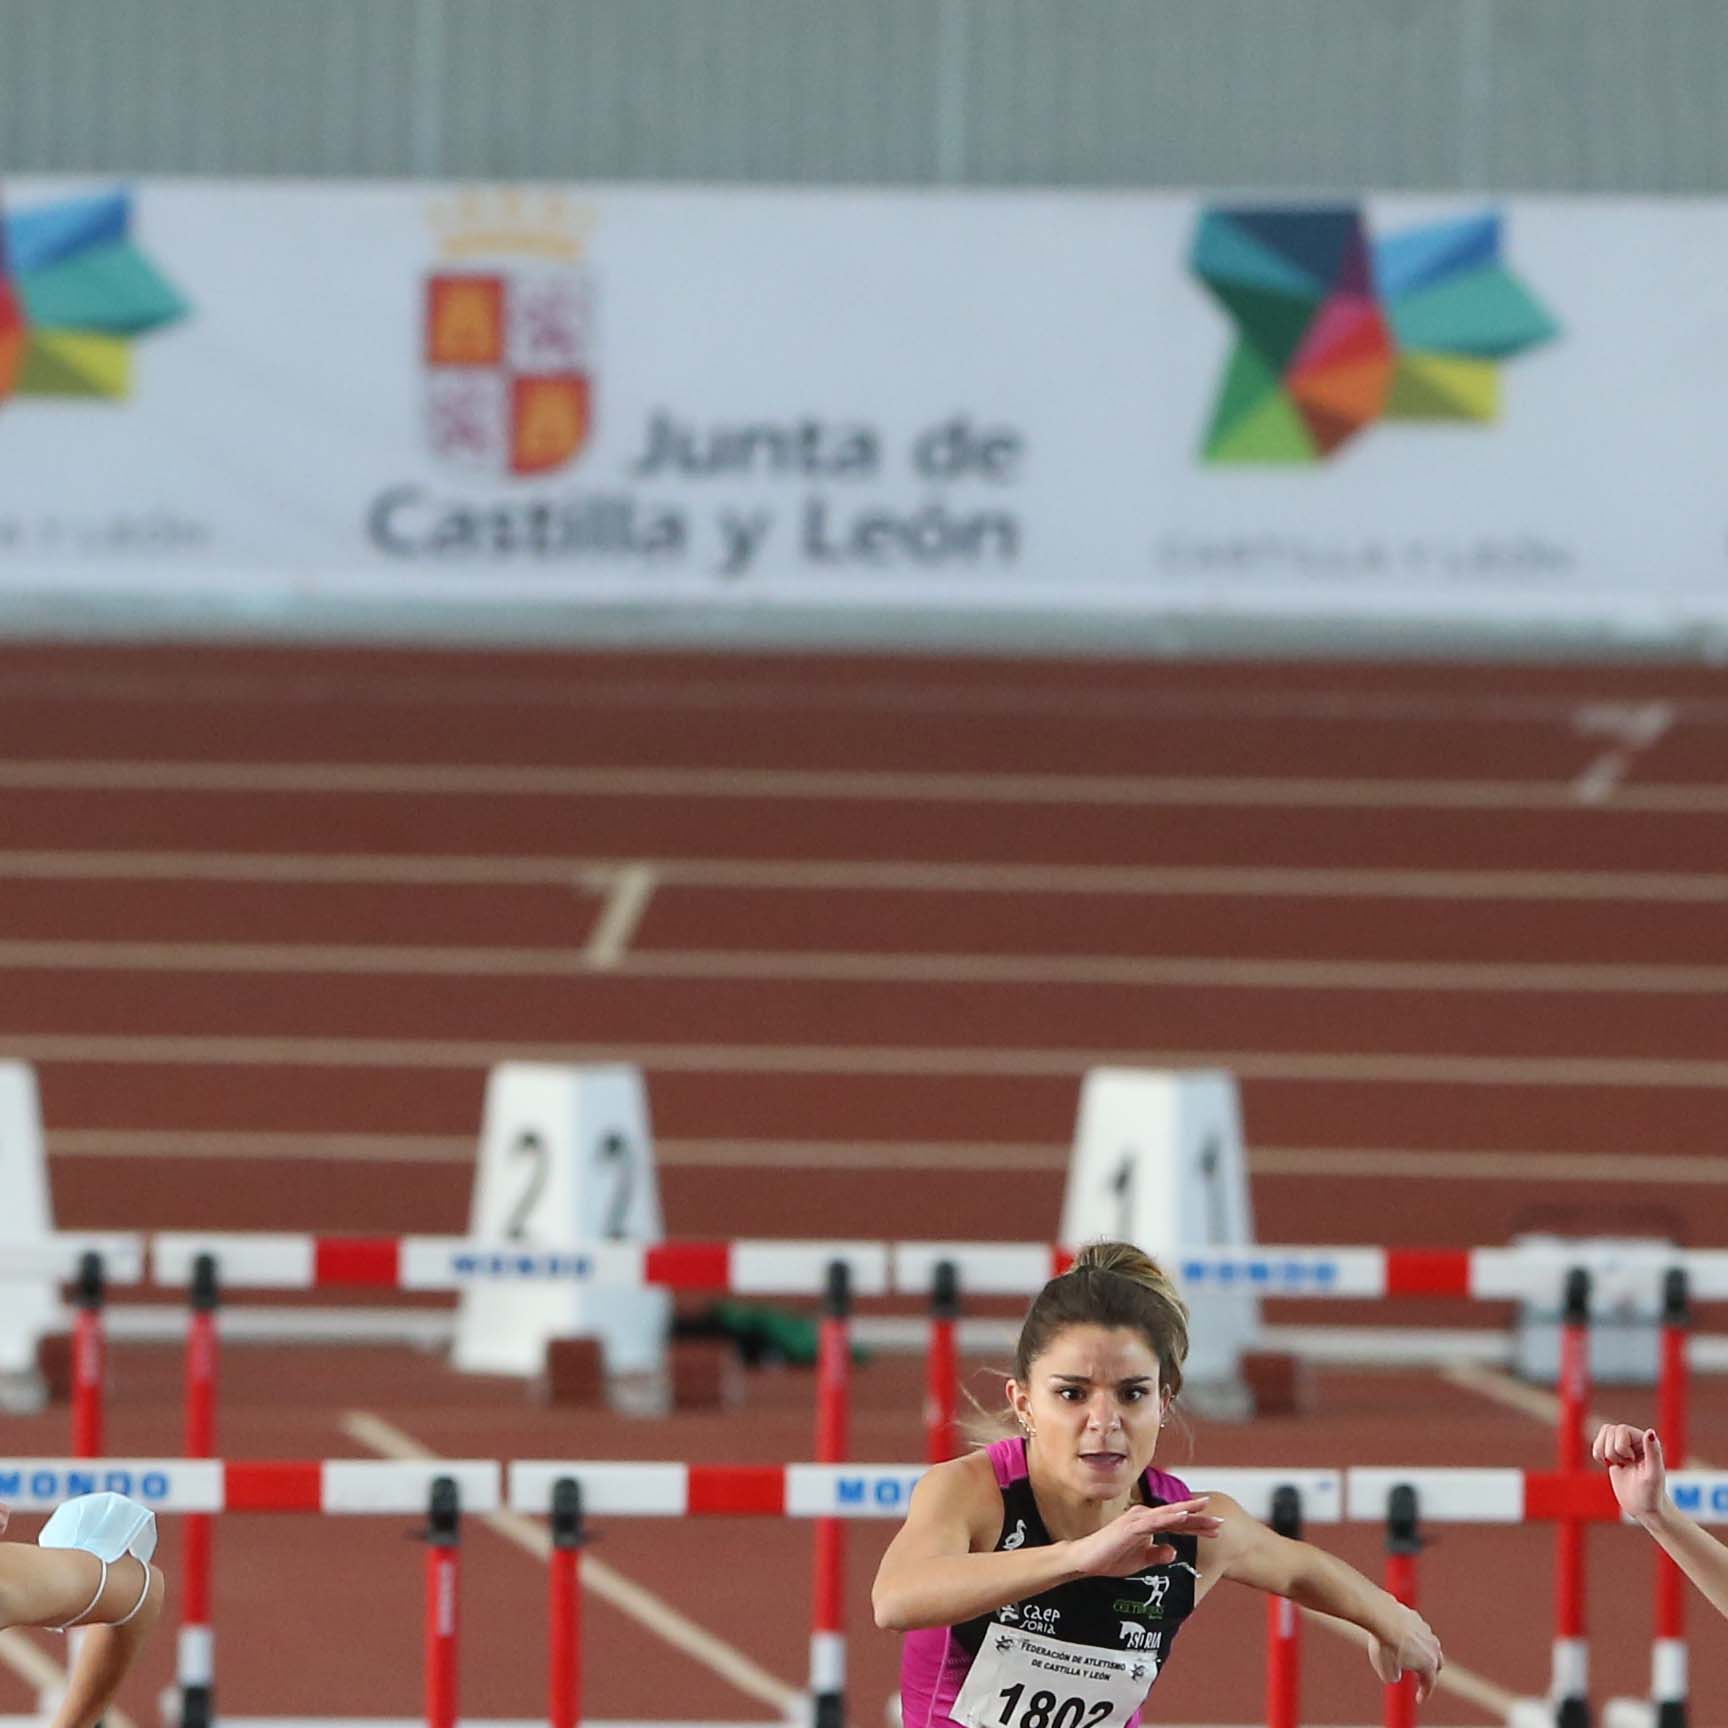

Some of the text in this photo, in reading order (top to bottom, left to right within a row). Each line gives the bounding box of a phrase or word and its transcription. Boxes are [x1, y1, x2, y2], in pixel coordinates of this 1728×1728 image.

[632, 408, 1023, 480] Junta de
[365, 486, 1021, 579] Castilla y León
[503, 1129, 550, 1241] 2
[599, 1132, 638, 1241] 2
[1020, 1640, 1127, 1672] FEDERACIÓN DE ATLETISMO
[1031, 1658, 1042, 1668] DE
[1043, 1662, 1081, 1677] CASTILLA
[1089, 1669, 1112, 1682] LEÓN
